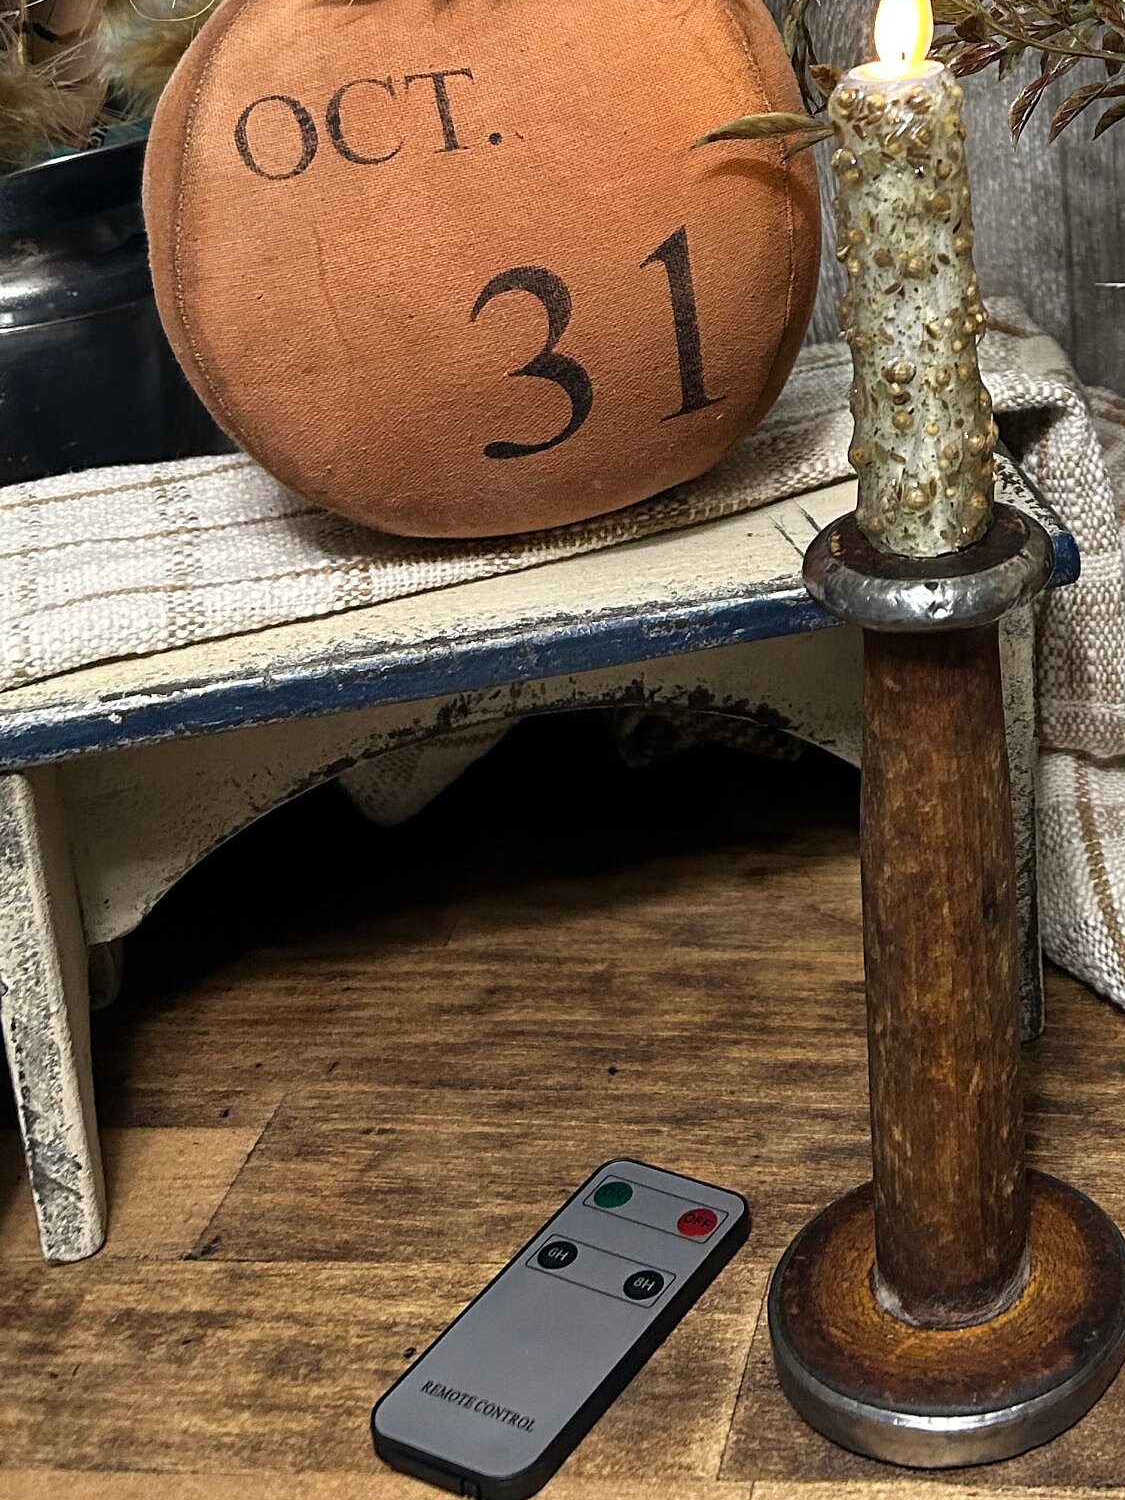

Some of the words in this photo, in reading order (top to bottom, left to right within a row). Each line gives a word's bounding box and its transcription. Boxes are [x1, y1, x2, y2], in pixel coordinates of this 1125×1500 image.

[234, 67, 503, 181] OCT.
[469, 225, 727, 459] 31
[603, 1186, 625, 1201] ON
[683, 1213, 714, 1229] OFF
[547, 1247, 570, 1262] 6H
[633, 1276, 656, 1292] 8H
[420, 1380, 477, 1409] REMOTE
[474, 1399, 536, 1433] CONTROL
